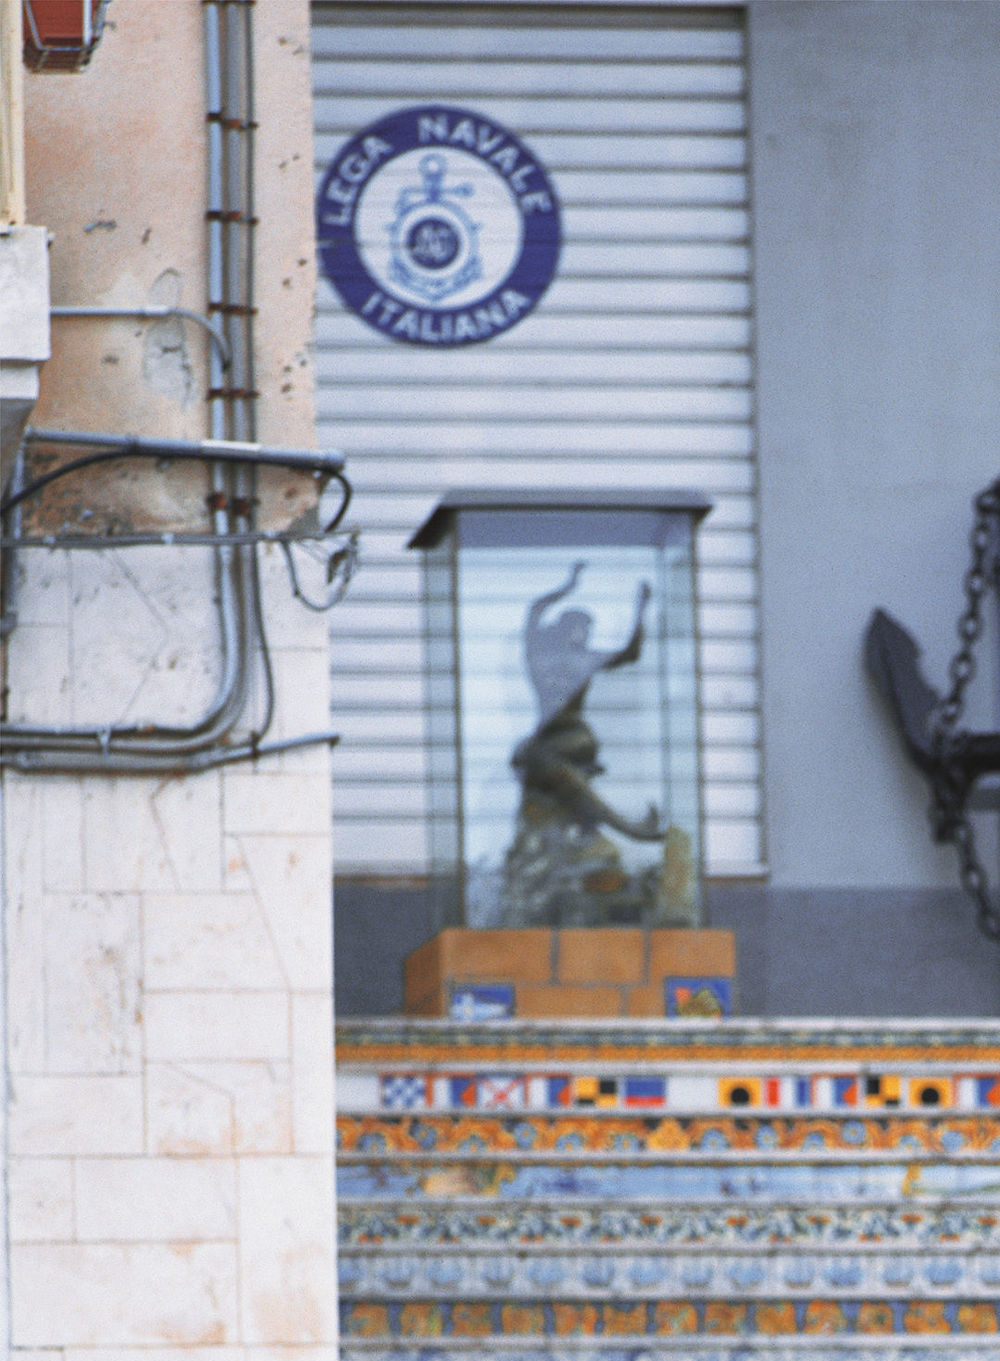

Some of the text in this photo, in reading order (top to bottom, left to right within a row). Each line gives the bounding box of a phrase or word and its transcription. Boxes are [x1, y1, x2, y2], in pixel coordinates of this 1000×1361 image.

[320, 114, 553, 228] LEGA NAVALE
[360, 289, 532, 342] ITALIANA
